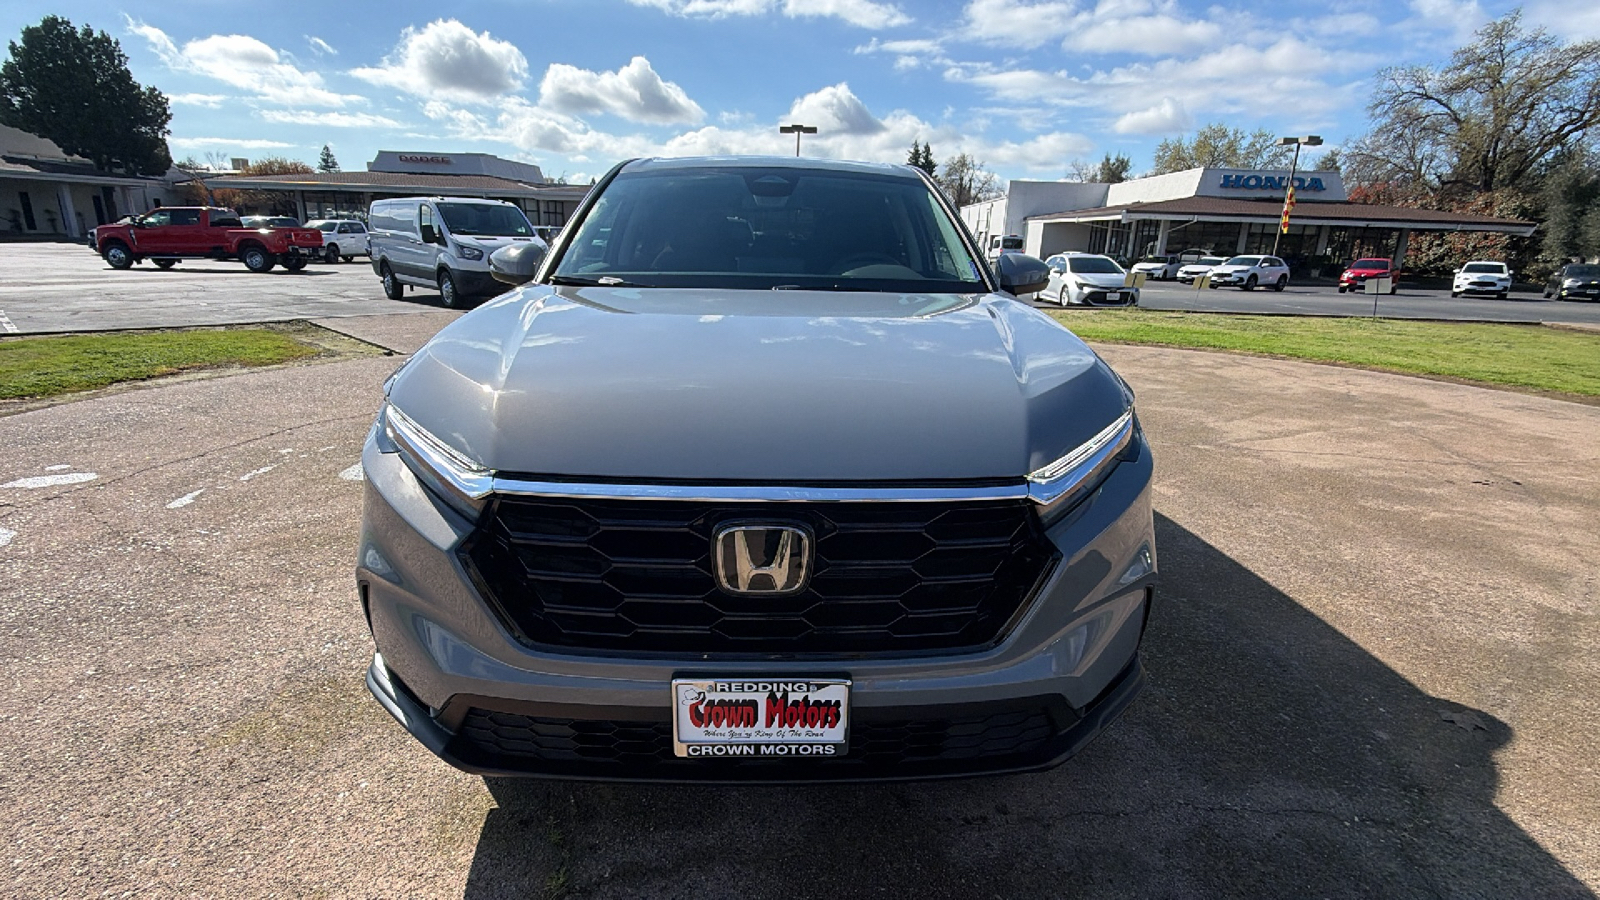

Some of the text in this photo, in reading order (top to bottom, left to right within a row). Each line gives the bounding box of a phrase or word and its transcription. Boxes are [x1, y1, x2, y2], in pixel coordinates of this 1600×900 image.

[399, 155, 451, 165] DODGE
[1220, 174, 1326, 191] HONDA
[716, 682, 808, 693] REDDING
[689, 692, 841, 729] Crown Motors
[703, 729, 726, 737] Where
[754, 729, 774, 739] King
[776, 729, 786, 739] Of
[788, 729, 802, 737] The
[804, 729, 825, 737] Road
[688, 744, 836, 756] CROWN MOTORS
